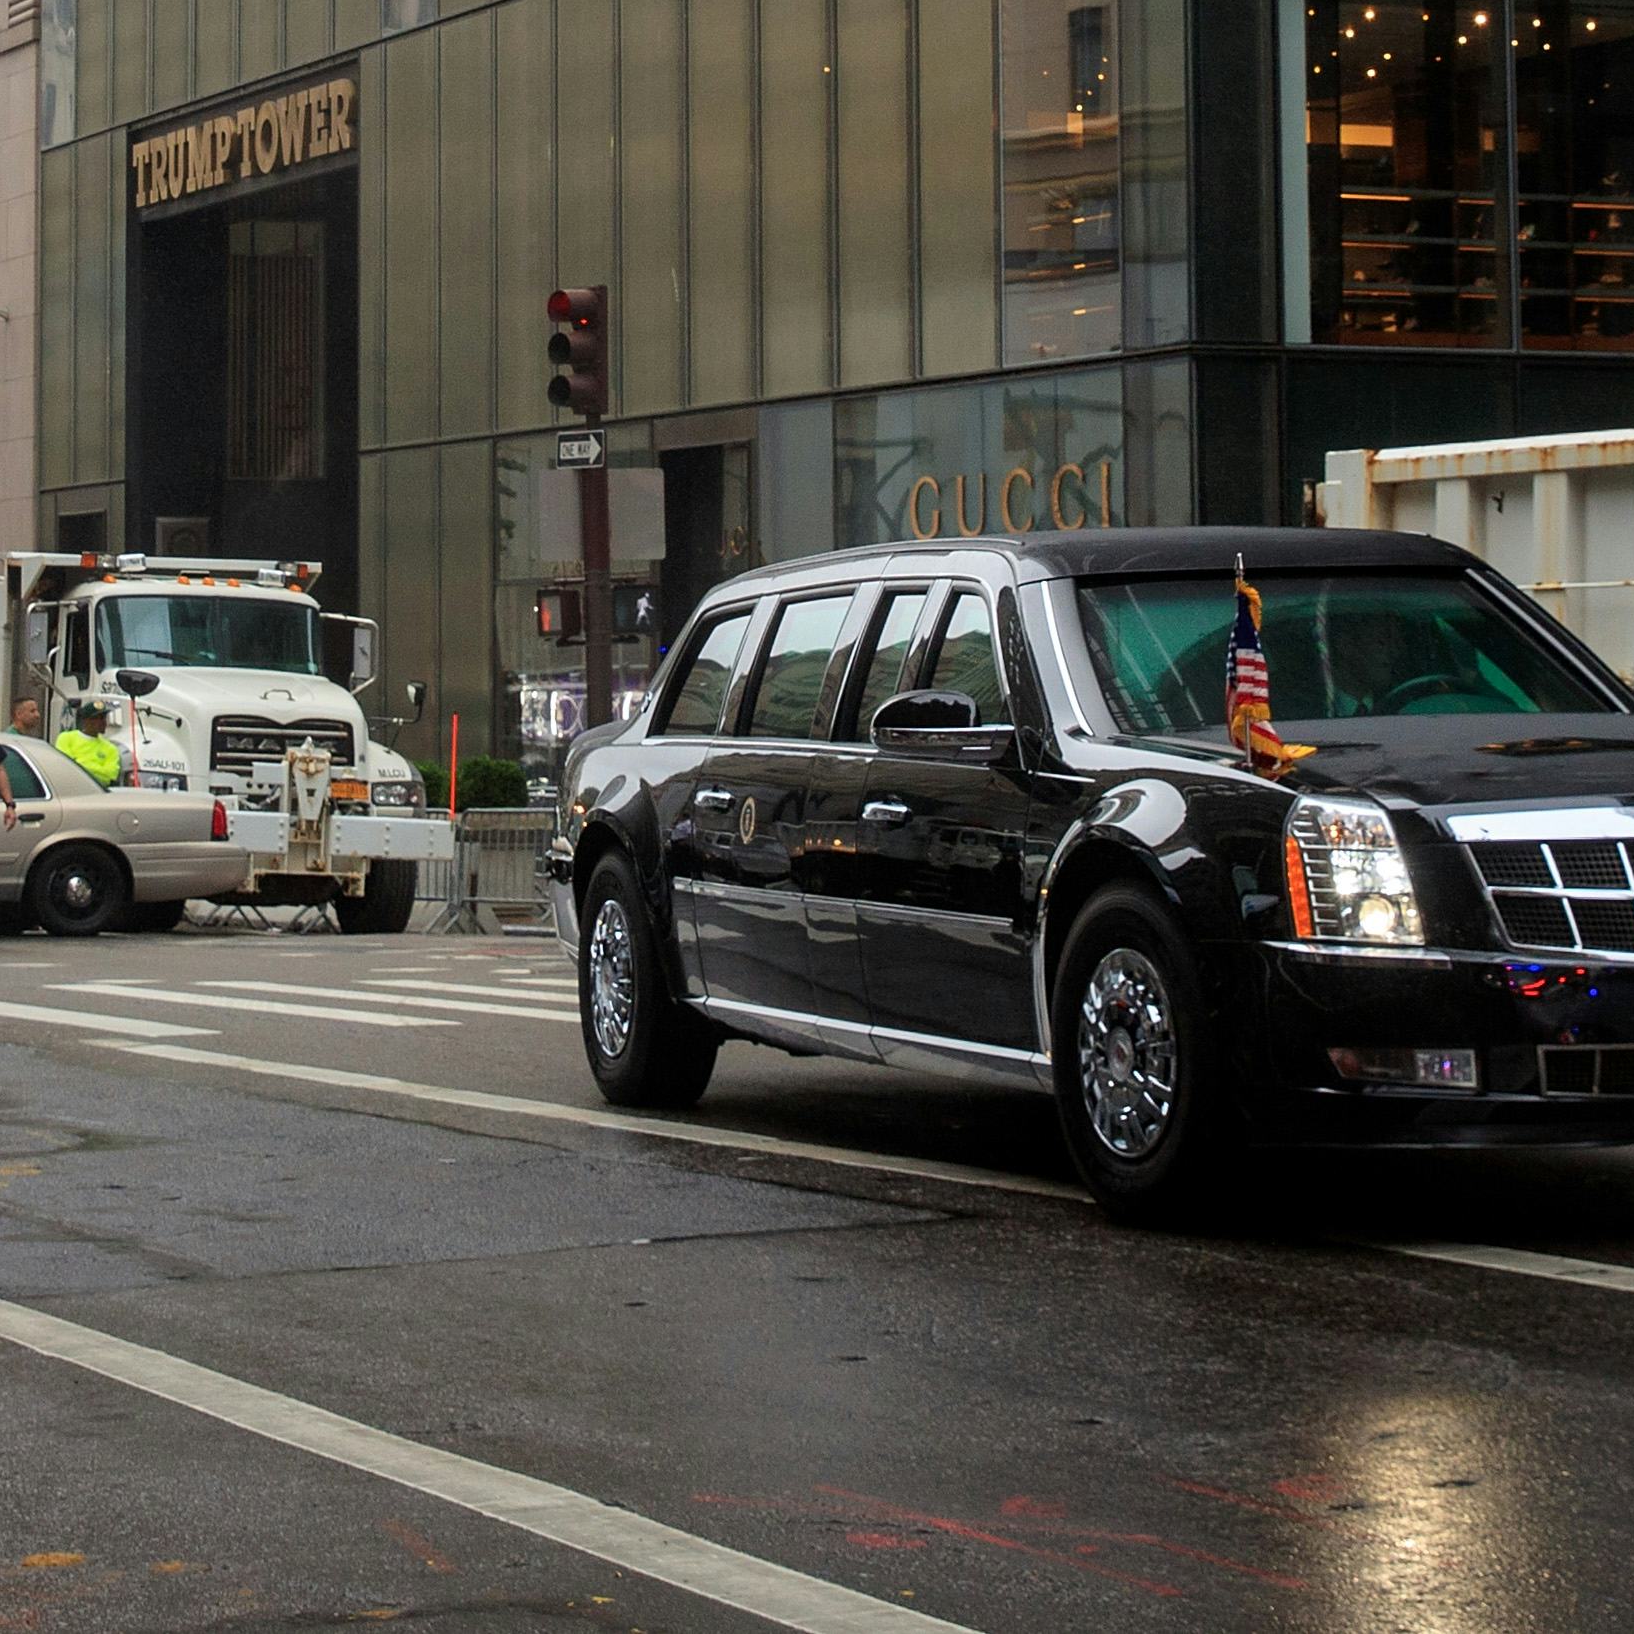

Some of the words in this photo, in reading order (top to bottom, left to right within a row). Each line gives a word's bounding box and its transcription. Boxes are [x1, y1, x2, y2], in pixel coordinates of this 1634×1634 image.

[133, 116, 237, 208] TRUMP
[237, 78, 355, 178] TOWER
[562, 444, 575, 457] ONE
[578, 443, 591, 454] WAY
[909, 461, 1111, 540] GUCCI
